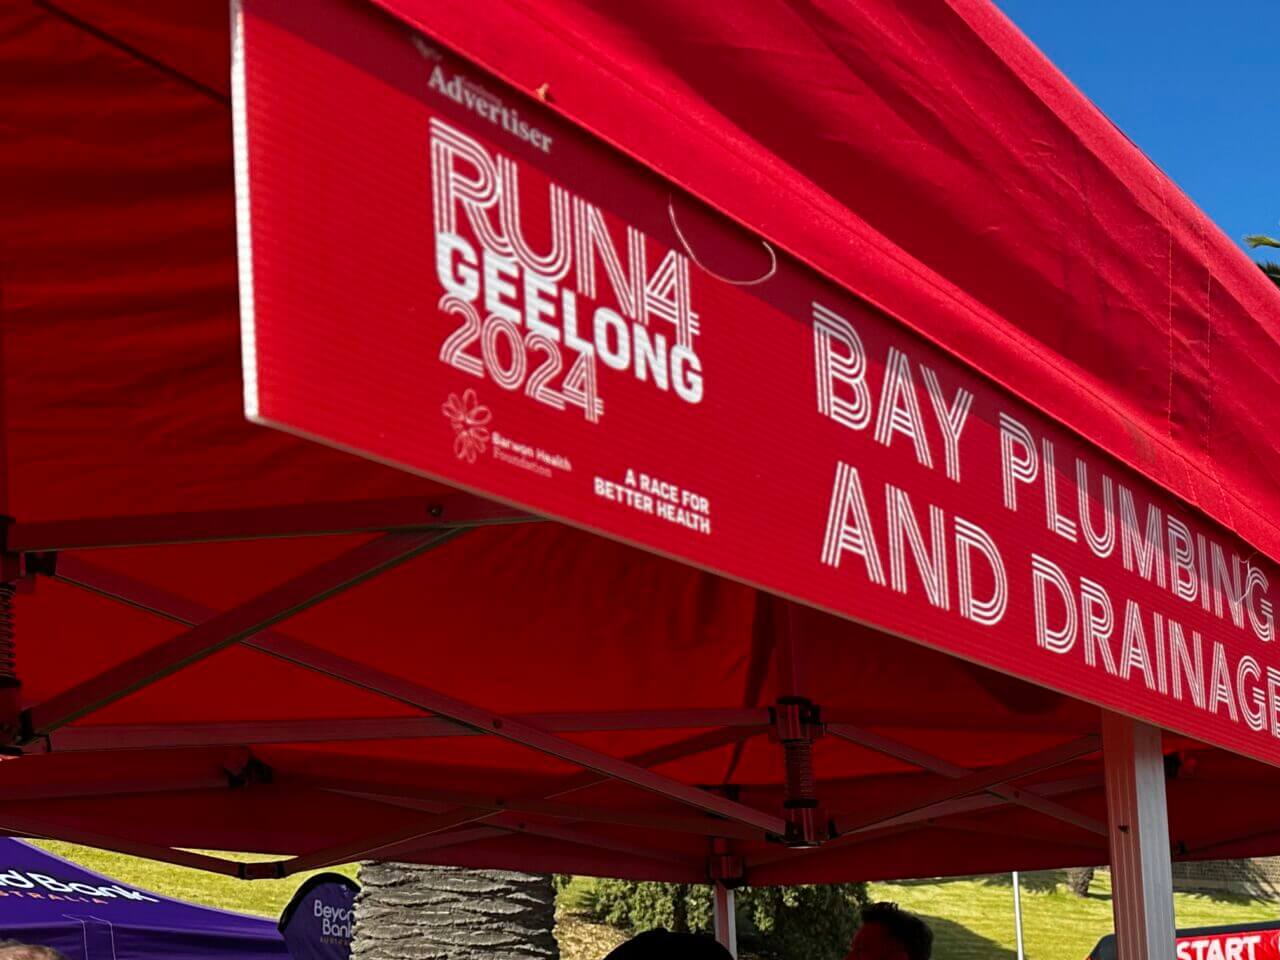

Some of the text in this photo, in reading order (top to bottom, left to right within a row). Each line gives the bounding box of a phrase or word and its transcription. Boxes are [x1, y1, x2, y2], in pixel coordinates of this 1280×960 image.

[428, 64, 552, 152] Advertiser
[429, 117, 700, 350] RUN4
[435, 232, 703, 404] GEELONG
[438, 293, 604, 424] 2024
[491, 431, 572, 472] Barwon Health
[493, 446, 552, 478] Foundation
[624, 468, 710, 514] A RACE FOR
[811, 302, 1275, 642] BAY PLUMBING
[594, 476, 711, 535] BETTER HEALTH
[820, 461, 1008, 626] AND
[27, 872, 160, 902] Bank
